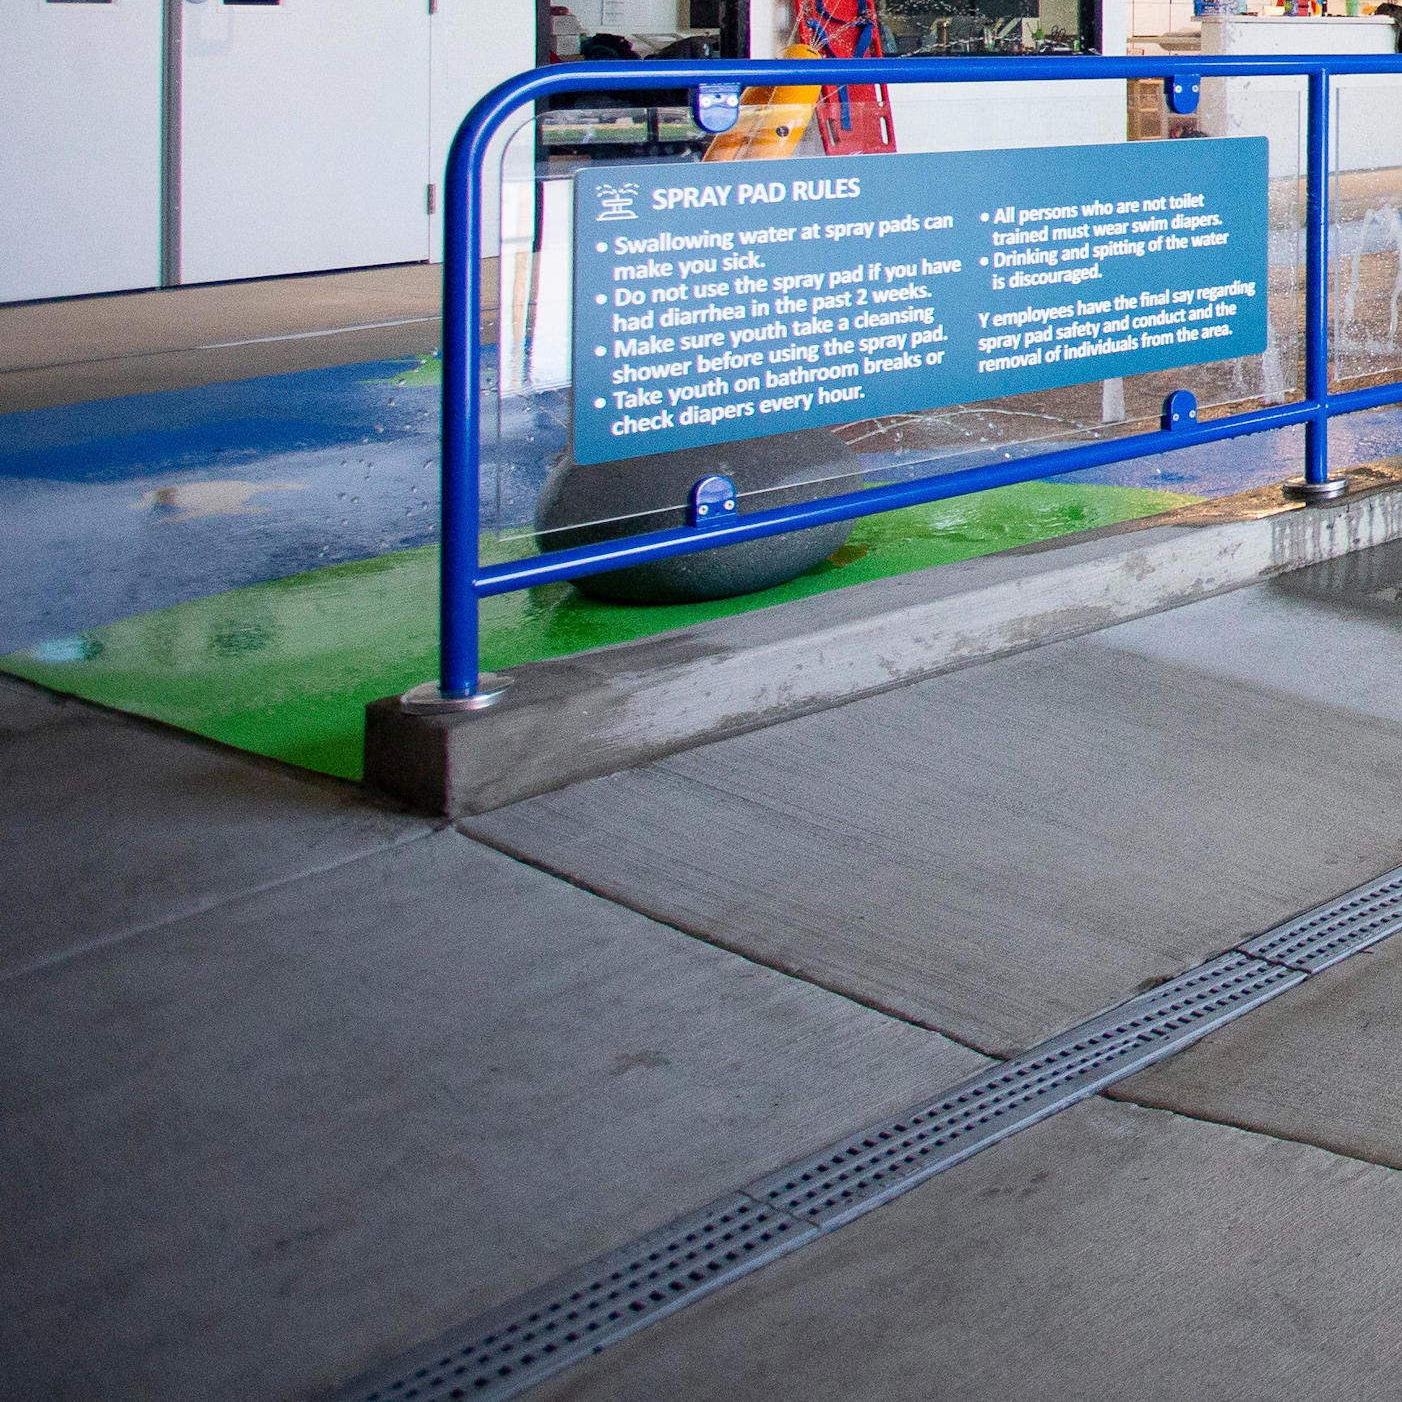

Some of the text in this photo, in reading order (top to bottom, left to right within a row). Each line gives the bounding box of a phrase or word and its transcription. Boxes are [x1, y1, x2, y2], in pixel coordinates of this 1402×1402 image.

[651, 177, 859, 210] SPRAY PAD RULES
[993, 192, 1204, 225] All persons who are not toilet
[614, 214, 952, 255] Swallowing water at spray pads can
[991, 213, 1222, 246] trained must wear swim diapers.
[993, 232, 1228, 268] Drinking and spitting of the water
[613, 250, 764, 280] make you sick.
[614, 258, 961, 306] Do not use the spray pad if you have
[991, 262, 1102, 290] is discouraged.
[612, 282, 931, 332] had diarrhea in the past 2 weeks.
[977, 280, 1255, 328] Y employees have the final say regarding
[977, 301, 1236, 353] spray pad safety and conduct and the
[612, 324, 947, 384] shower before using the spray pad.
[613, 305, 934, 358] Make sure youth take a cleansing
[978, 324, 1232, 372] removal of individuals from the area.
[612, 350, 944, 409] Take youth on bathroom breaks or
[611, 385, 864, 435] check diapers every hour.
